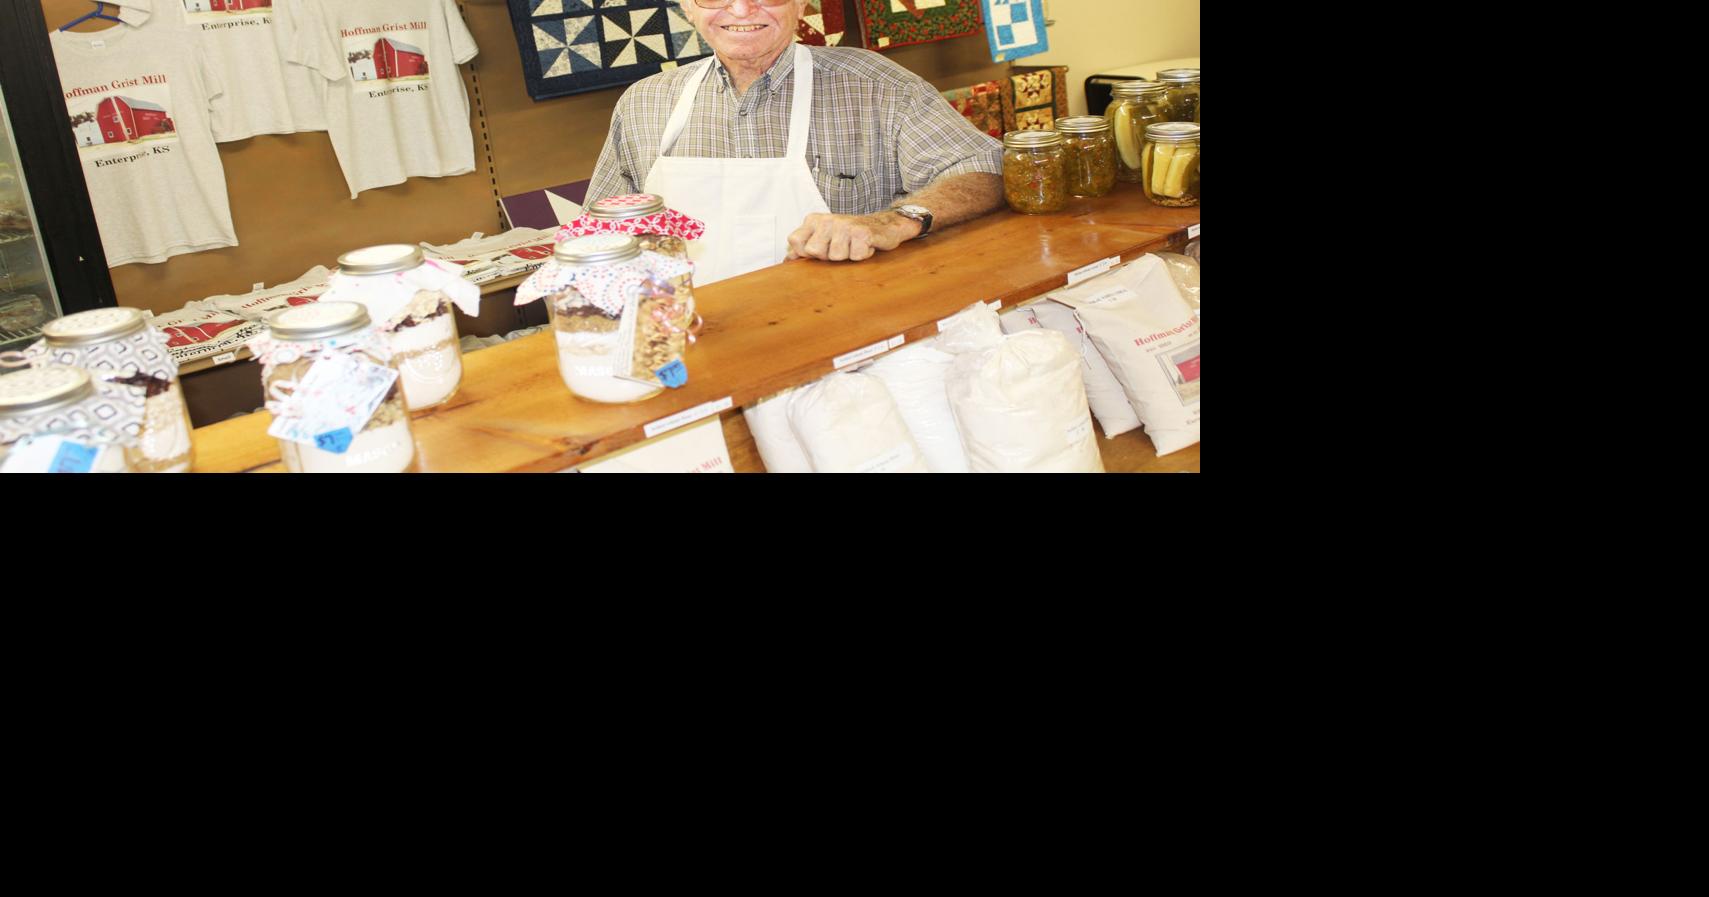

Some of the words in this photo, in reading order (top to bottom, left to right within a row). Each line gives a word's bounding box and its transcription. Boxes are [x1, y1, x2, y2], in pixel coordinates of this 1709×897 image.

[262, 17, 273, 25] K
[340, 26, 381, 38] Hoffman
[382, 23, 407, 32] Grist
[409, 21, 427, 30] Mill
[64, 84, 109, 99] offman
[111, 78, 138, 89] Grist
[142, 74, 167, 85] Mill
[152, 145, 170, 155] KS
[700, 456, 722, 471] Mill
